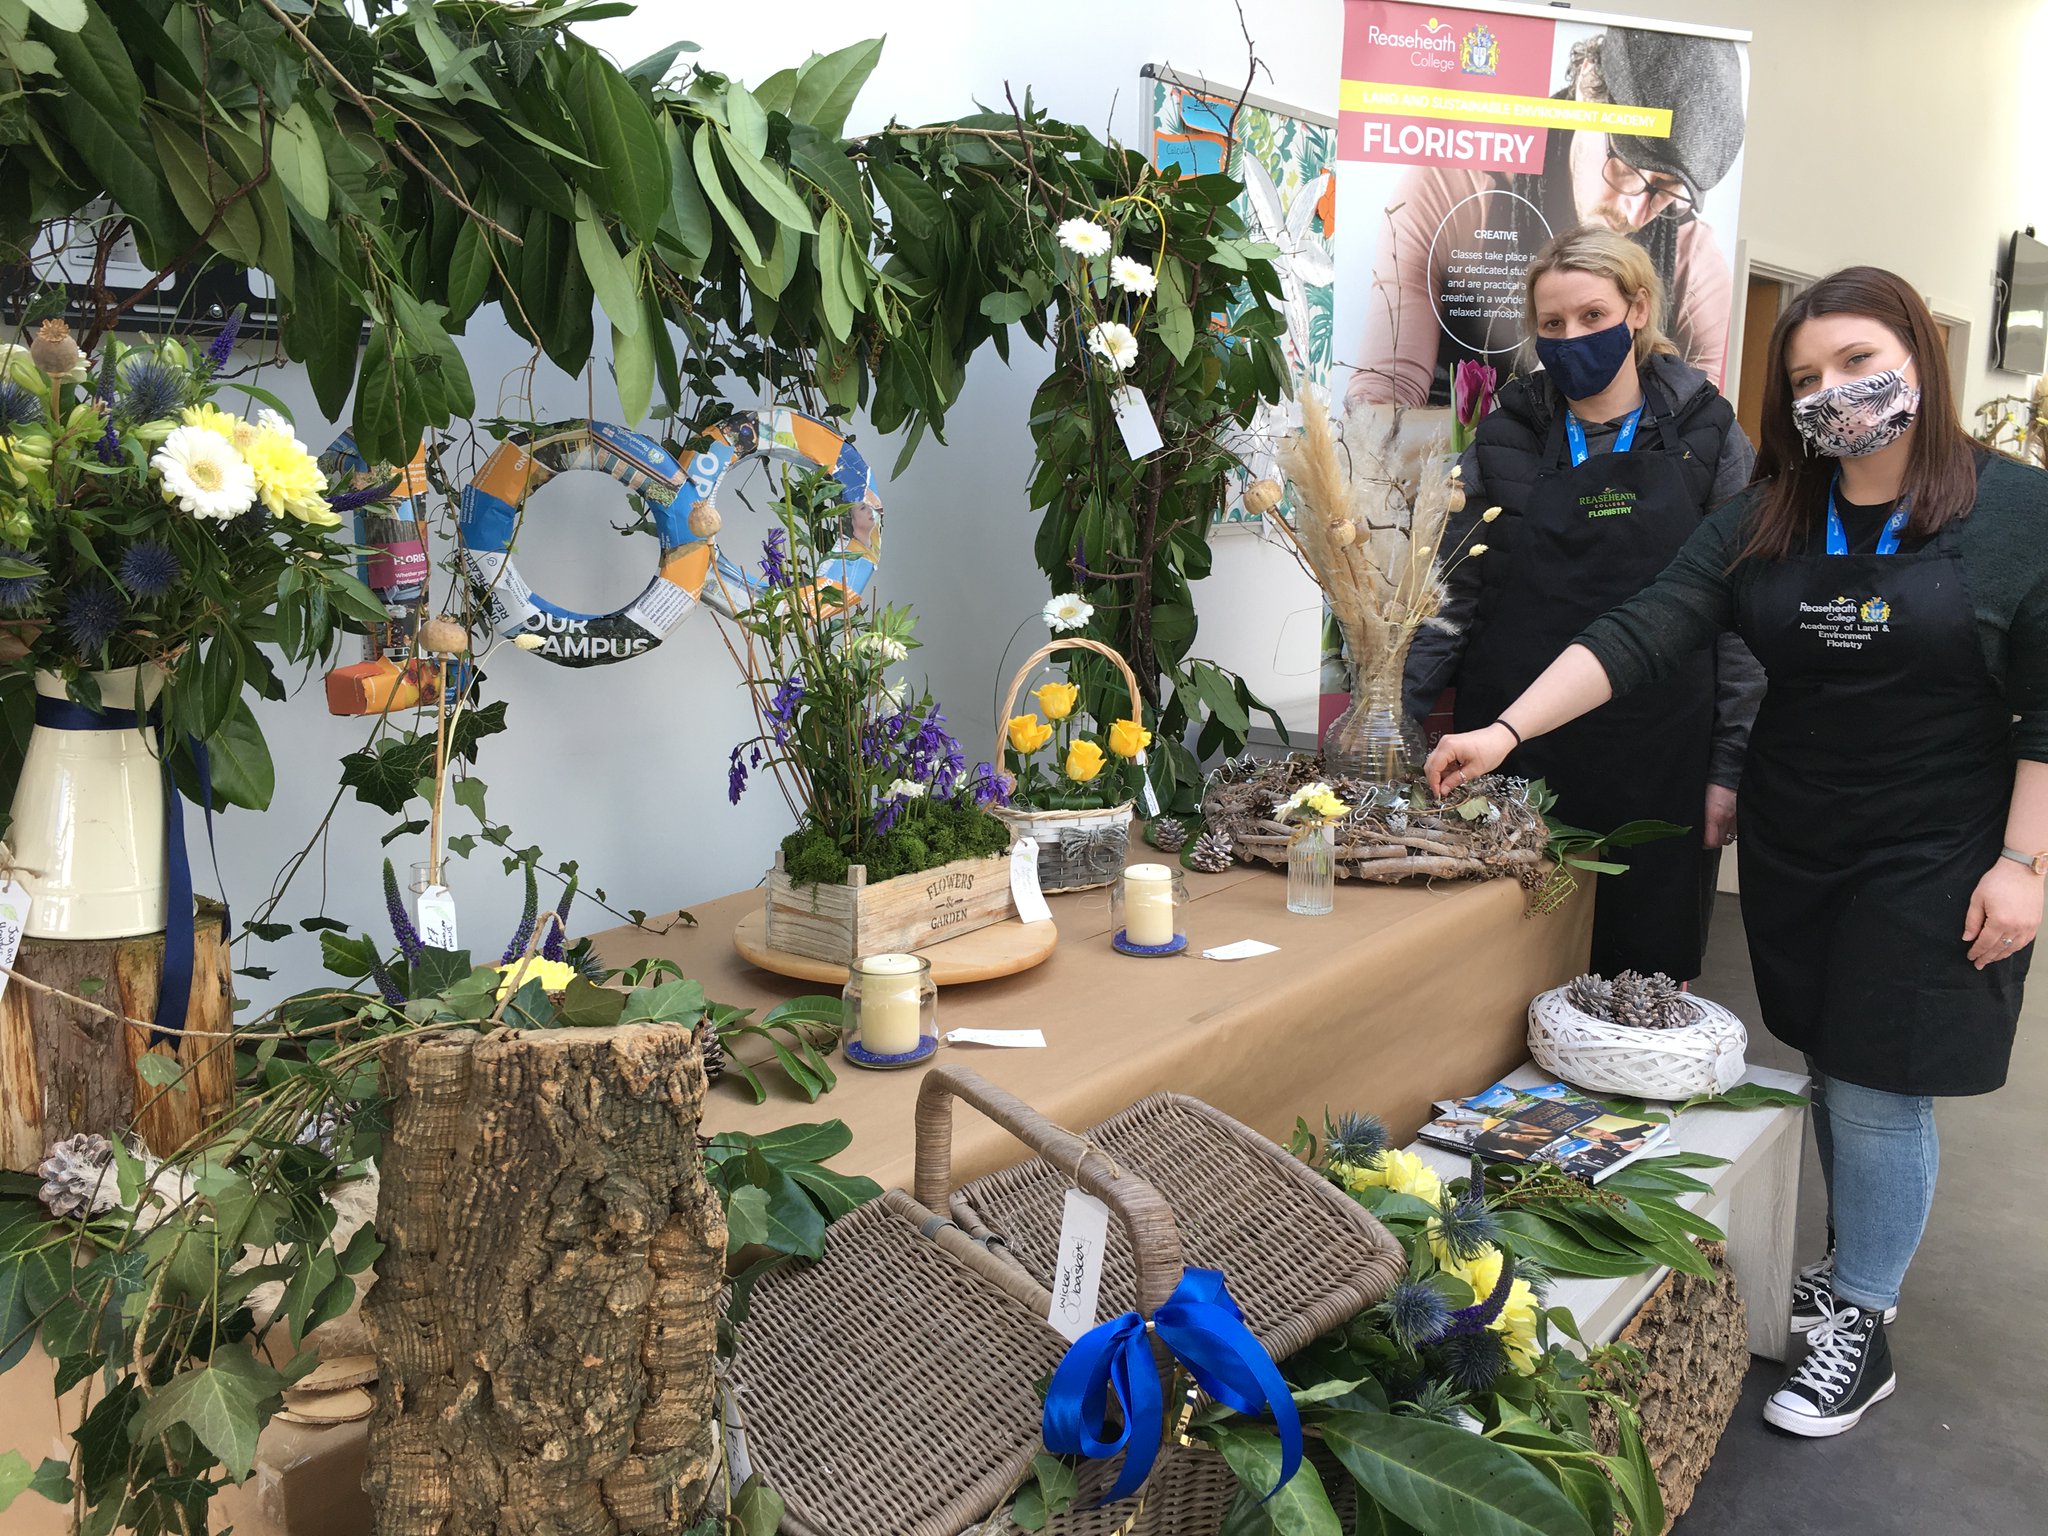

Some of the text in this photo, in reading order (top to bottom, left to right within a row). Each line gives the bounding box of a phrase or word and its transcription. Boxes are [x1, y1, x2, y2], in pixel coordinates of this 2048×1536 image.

[1368, 25, 1456, 53] Reaseheath
[1410, 51, 1455, 73] College
[1362, 91, 1656, 129] LAND AND SUSTAINABLE ENVIRONMENT ACADEMY
[1363, 121, 1535, 165] FLORISTRY
[1474, 229, 1518, 241] CREATIVE
[1450, 249, 1482, 260] Classes
[1484, 251, 1503, 261] take
[1505, 252, 1528, 263] place
[1447, 264, 1463, 274] our
[1464, 265, 1508, 276] dedicated
[1447, 279, 1465, 288] and
[1483, 281, 1519, 291] practical
[1440, 293, 1475, 302] creative
[1476, 294, 1485, 303] in
[1449, 308, 1481, 317] relaxed
[1579, 492, 1636, 505] REASEHEATH
[1594, 501, 1625, 509] COLLEGE
[1588, 506, 1632, 518] FLORISTRY
[1799, 602, 1857, 613] Reaseheath
[524, 613, 588, 634] OUR
[1800, 622, 1840, 632] Academy
[1857, 624, 1879, 632] Land
[1881, 624, 1890, 633] &
[1818, 631, 1872, 640] Environment
[539, 635, 649, 659] AMPUS
[1826, 639, 1862, 650] Floristry
[926, 873, 974, 901] FLOWERS
[945, 896, 954, 909] &
[930, 908, 968, 930] GARDEN
[8, 925, 19, 946] Jug
[1072, 1240, 1085, 1295] basket
[1059, 1266, 1071, 1309] wicker
